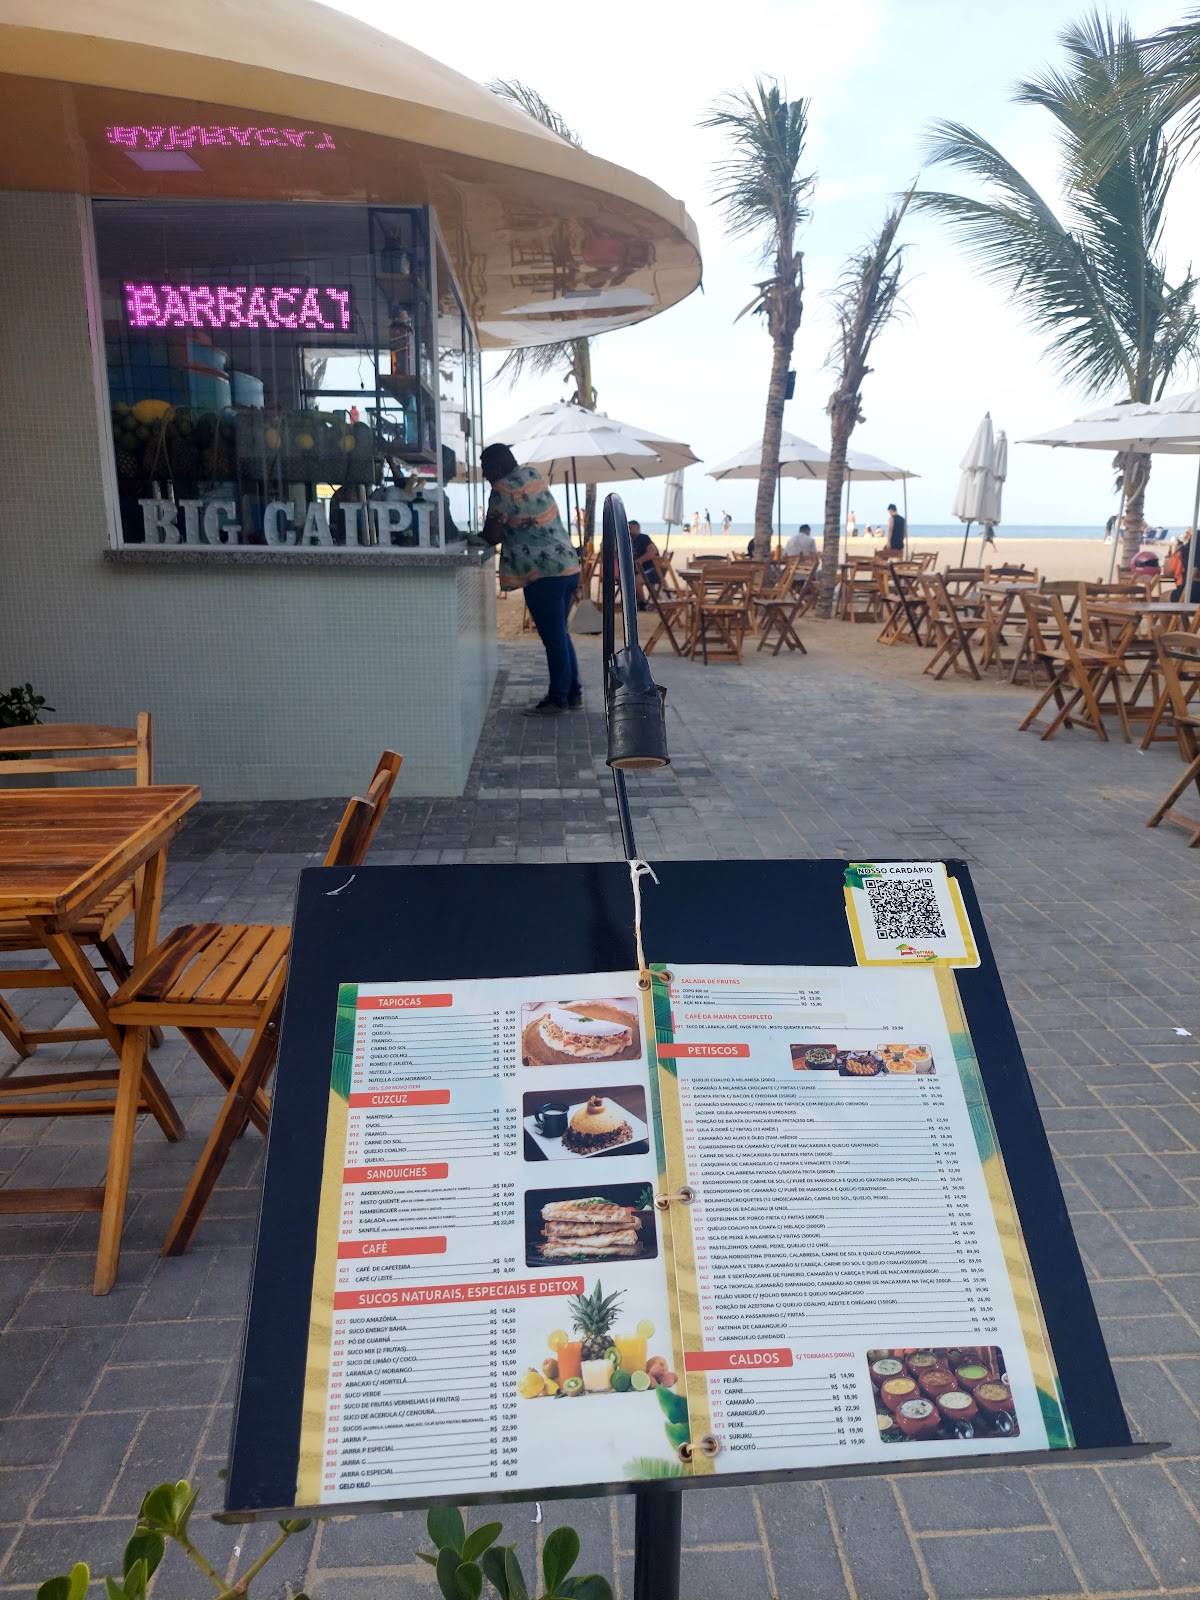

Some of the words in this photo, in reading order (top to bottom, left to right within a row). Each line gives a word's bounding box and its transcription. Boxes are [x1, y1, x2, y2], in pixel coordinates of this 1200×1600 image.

[126, 285, 334, 328] BARRACA
[138, 499, 242, 545] BIG
[263, 500, 435, 548] CAIPI
[857, 867, 887, 875] NOSSO
[889, 866, 933, 874] CARDÁPIO
[378, 998, 422, 1007] TAPIOCAS
[688, 1046, 738, 1055] PETISCOS
[372, 1094, 408, 1104] CUZCUZ
[366, 1167, 428, 1180] SANDUICHES
[362, 1241, 388, 1254] CAFÉ
[358, 1292, 399, 1304] SUCOS
[402, 1288, 465, 1302] NATURAIS,
[467, 1284, 526, 1298] ESPECIAIS
[530, 1283, 537, 1293] E
[539, 1281, 578, 1293] DETOX
[729, 1352, 780, 1365] CALDOS
[394, 1399, 429, 1407] VERMELHAS
